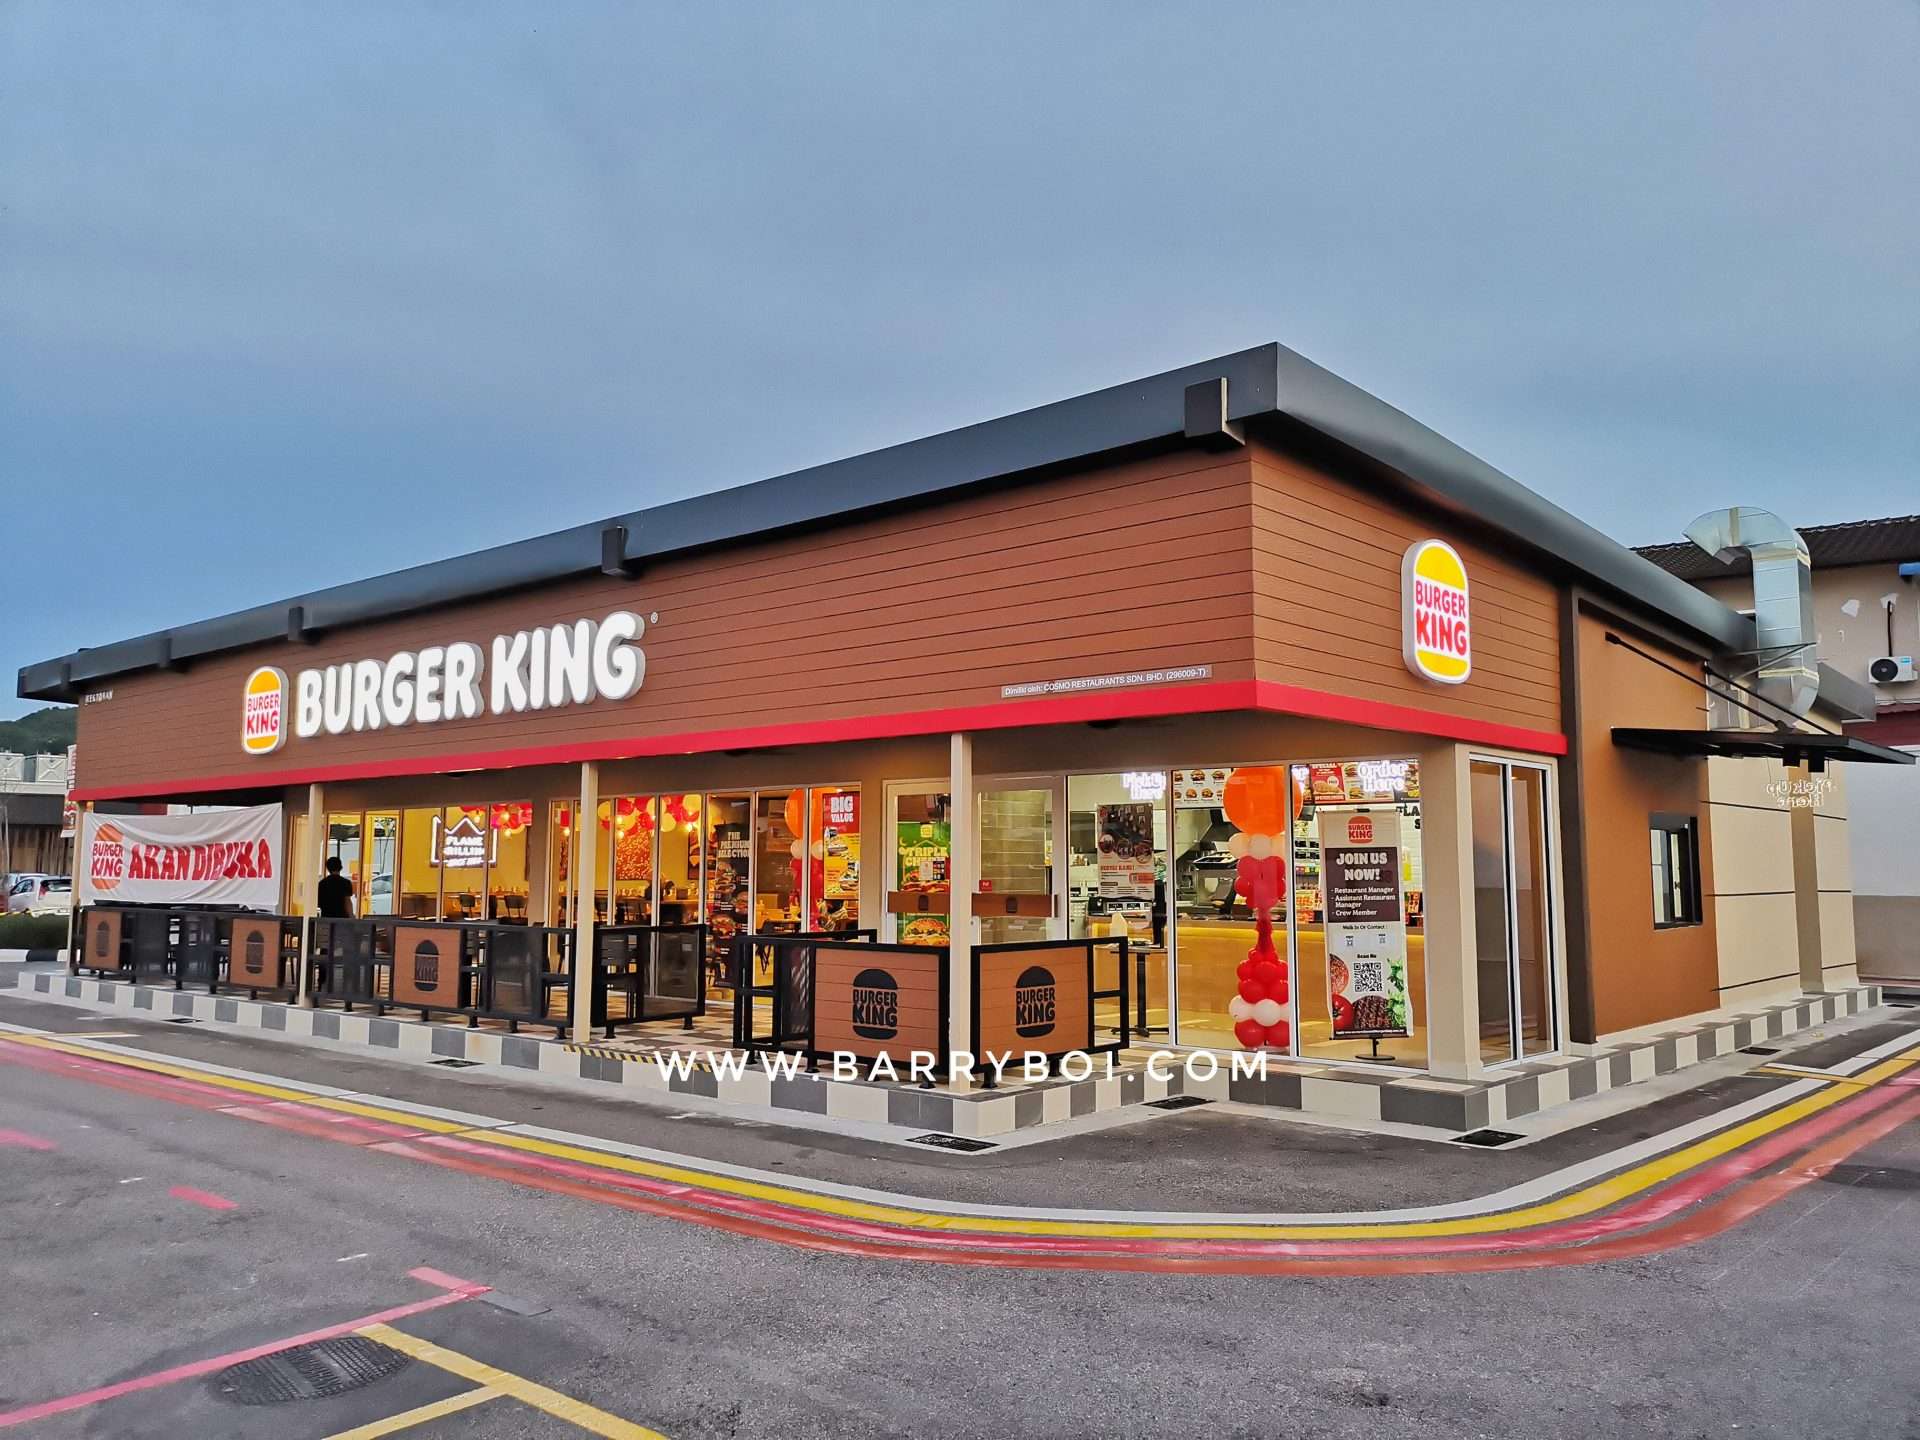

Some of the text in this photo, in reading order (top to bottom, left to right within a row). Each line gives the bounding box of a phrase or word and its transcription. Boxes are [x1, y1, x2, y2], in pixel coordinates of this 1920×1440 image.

[1415, 580, 1466, 618] BURGER
[1415, 608, 1467, 656] KING
[296, 611, 646, 738] BURGER KING
[1043, 681, 1071, 692] COSMO
[1071, 675, 1126, 689] RESTAURANTS
[1126, 674, 1145, 684] SDN.
[1146, 672, 1165, 682] BHD.
[247, 693, 280, 713] BURGER
[246, 710, 279, 735] KING
[830, 796, 854, 813] BIG
[831, 813, 854, 823] VALUE
[1348, 830, 1373, 840] KING
[92, 843, 123, 858] BURGER
[128, 837, 273, 881] AKAN DIBUKA
[908, 846, 949, 858] TRIPLE
[1336, 852, 1388, 866] JOIN US
[91, 856, 123, 878] KING
[1344, 868, 1381, 881] NOW!
[1367, 887, 1394, 895] Manager
[1335, 909, 1352, 917] Crew
[852, 989, 898, 1007] BURGER
[1015, 987, 1056, 1003] BURGER
[852, 1003, 898, 1027] KING
[1015, 1001, 1056, 1025] KING
